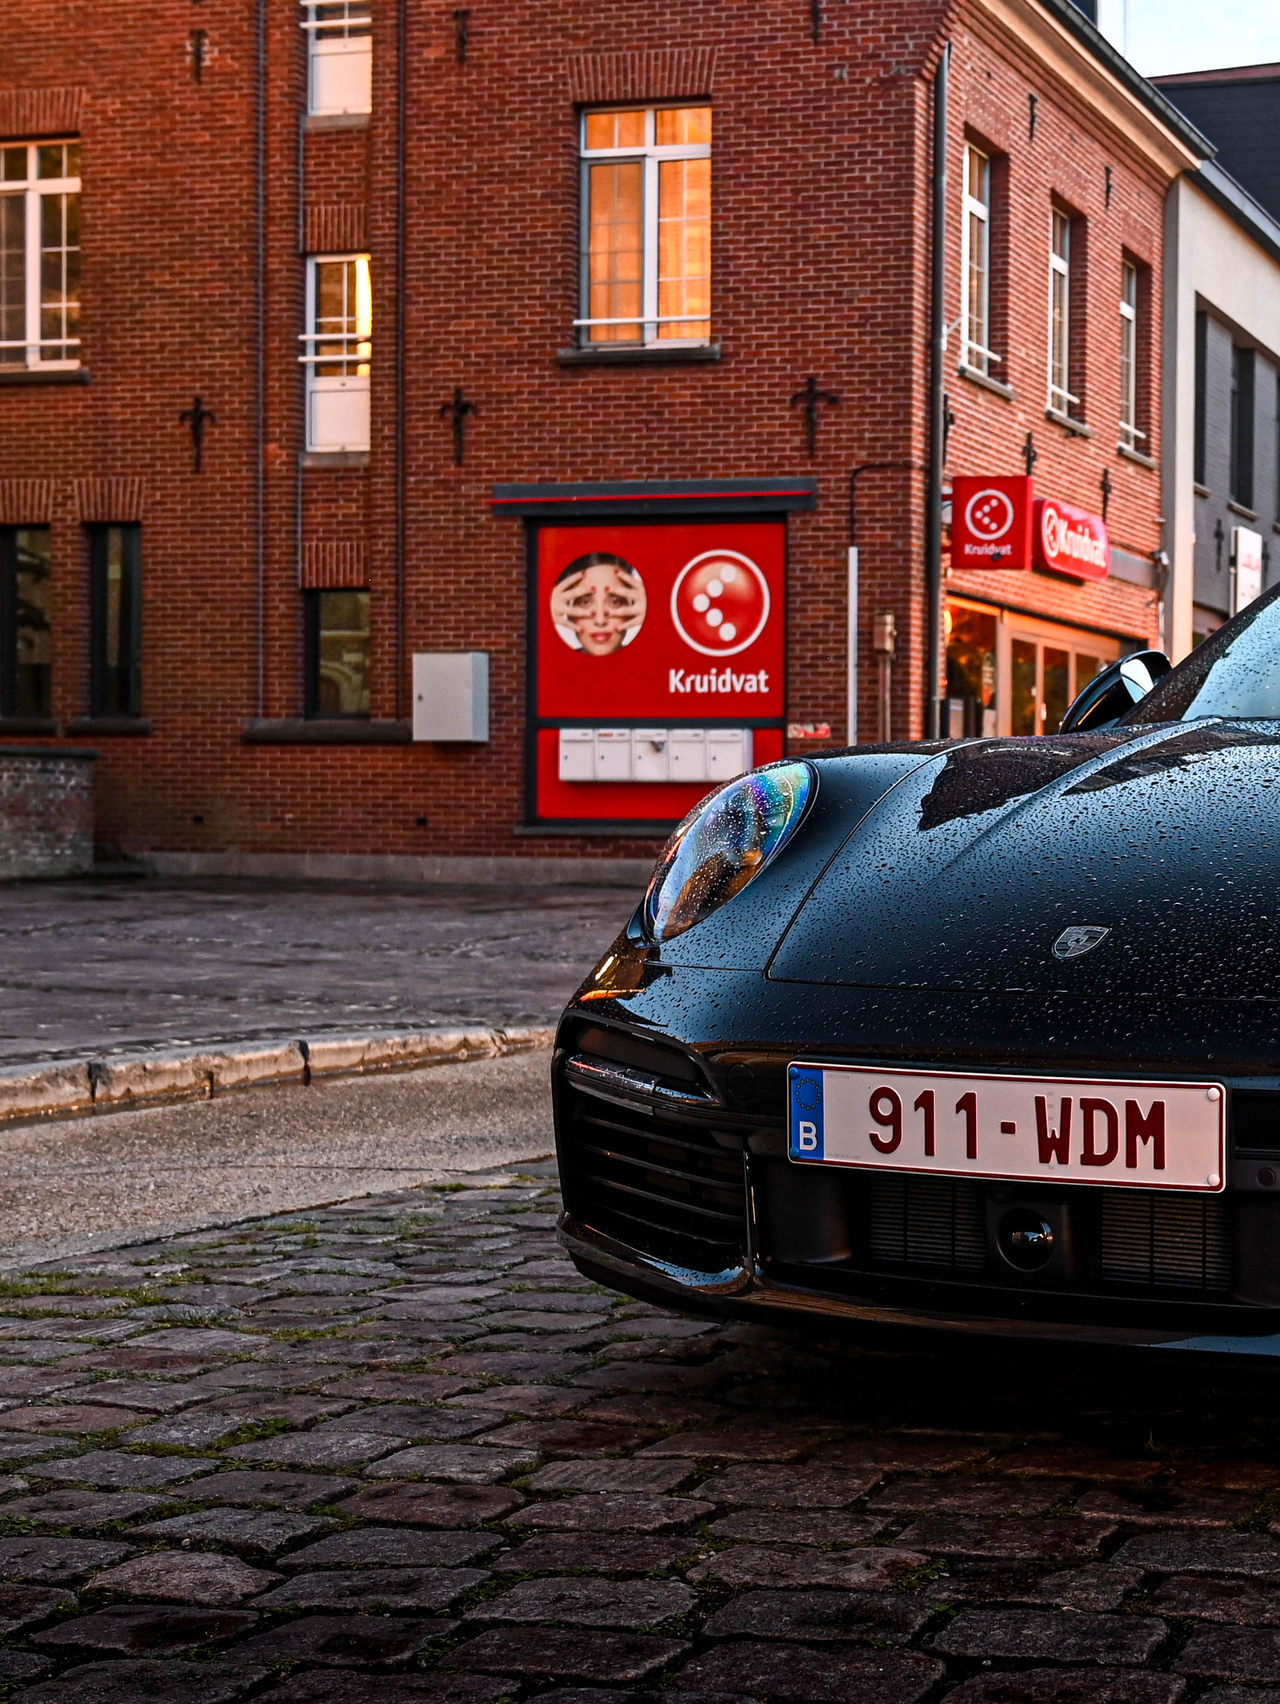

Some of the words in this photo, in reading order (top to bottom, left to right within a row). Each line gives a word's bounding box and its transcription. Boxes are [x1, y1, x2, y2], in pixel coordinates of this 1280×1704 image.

[964, 543, 1012, 555] Kruidvat
[1059, 518, 1106, 567] Kruidvat
[669, 668, 769, 693] Kruidvat
[799, 1121, 818, 1151] B
